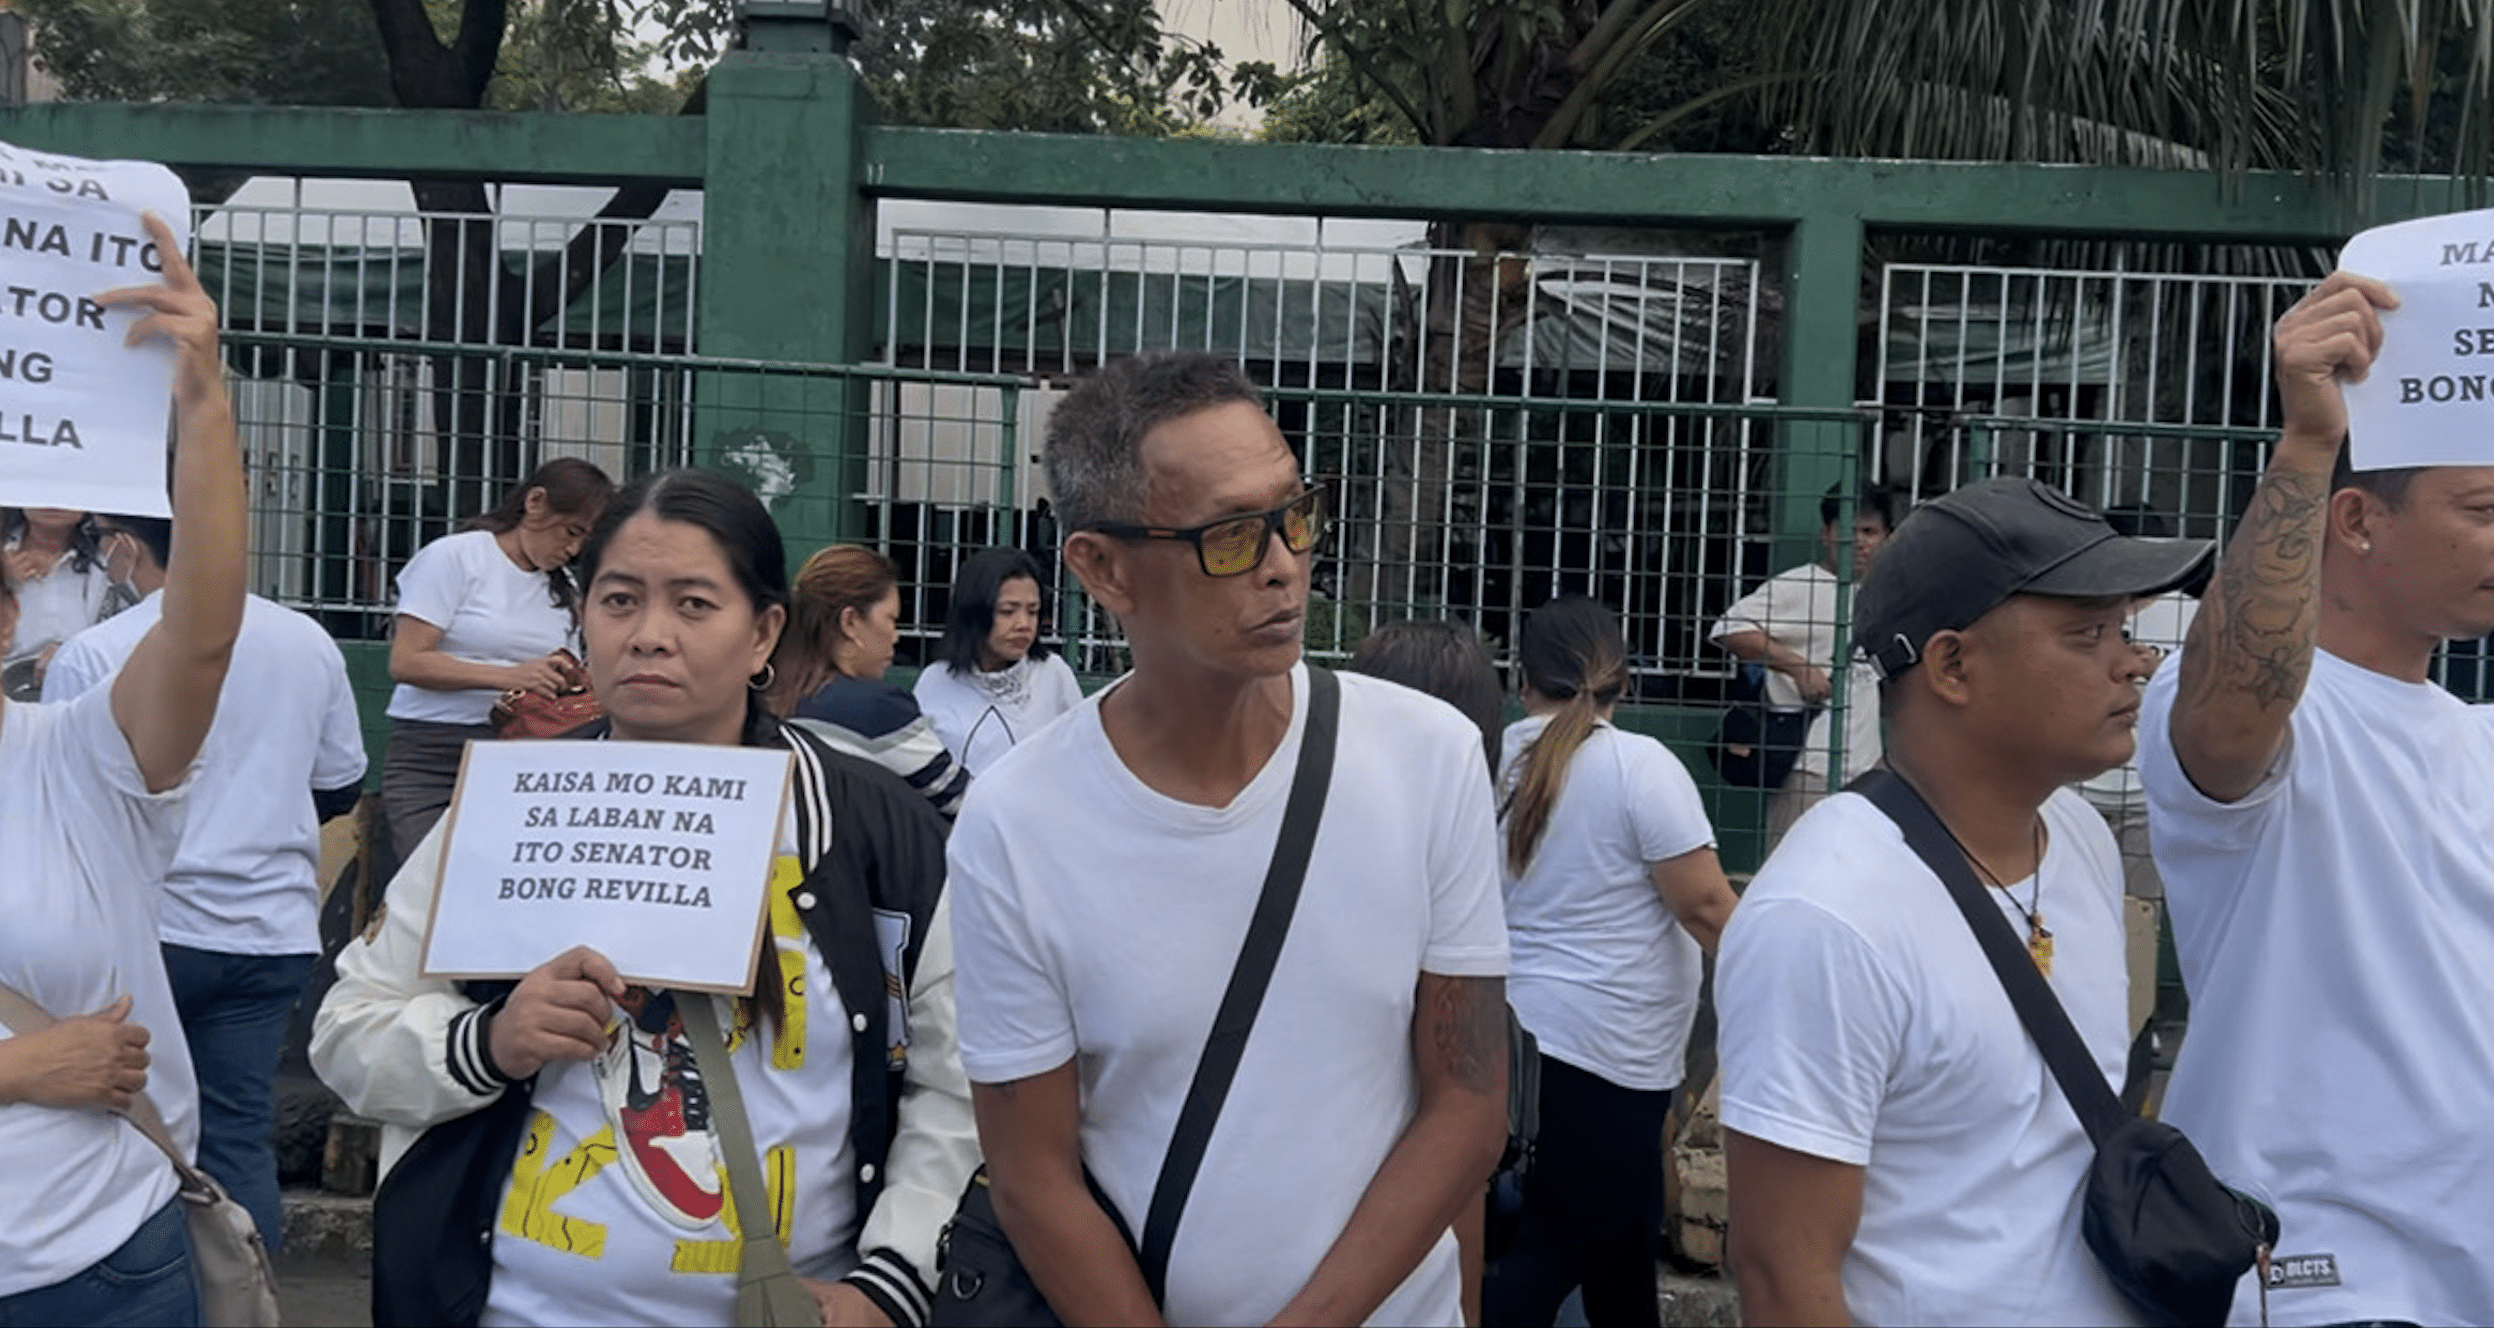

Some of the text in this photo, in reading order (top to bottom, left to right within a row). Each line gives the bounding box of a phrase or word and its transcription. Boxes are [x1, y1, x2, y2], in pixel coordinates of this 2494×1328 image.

[4, 217, 71, 257] NA
[2399, 374, 2494, 405] BON
[513, 771, 748, 801] KAISA MO KAMI
[524, 805, 715, 836] SA LABAN NA
[512, 840, 712, 872] ITO SENATOR
[497, 877, 713, 909] BONG REVILLA
